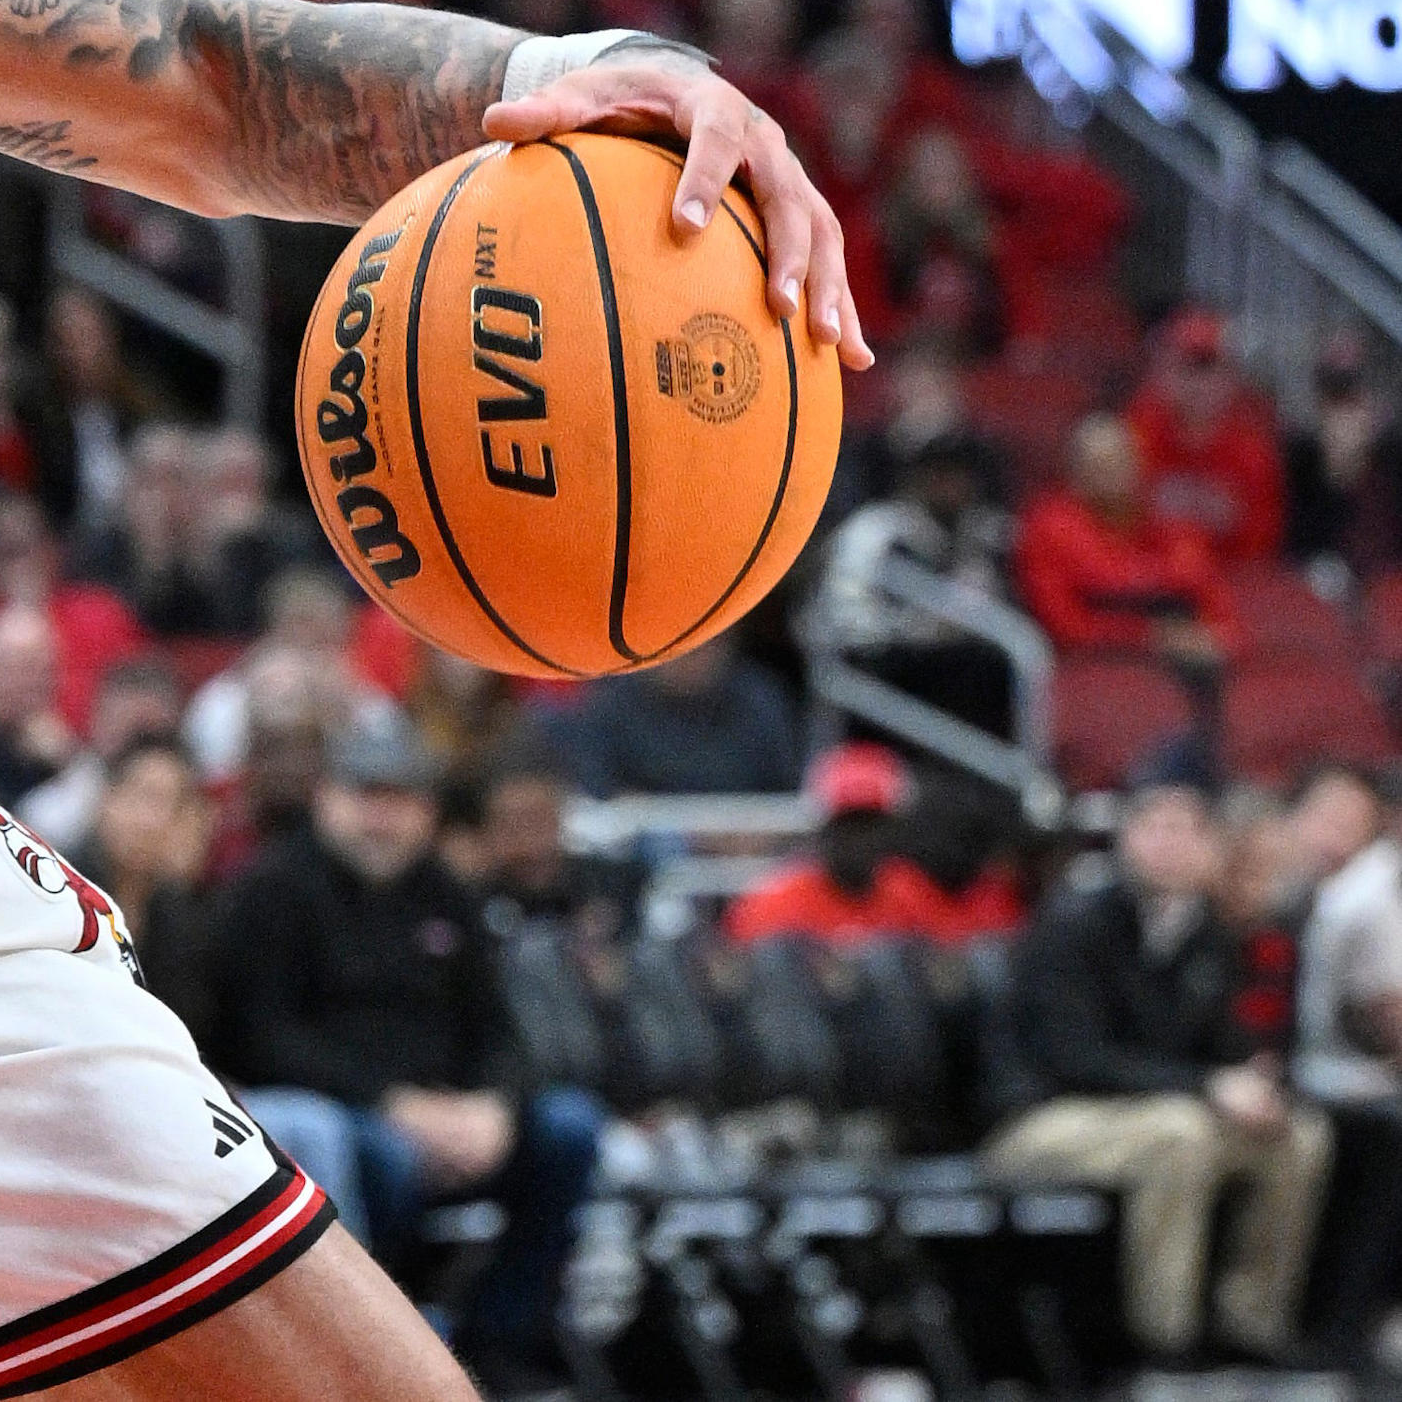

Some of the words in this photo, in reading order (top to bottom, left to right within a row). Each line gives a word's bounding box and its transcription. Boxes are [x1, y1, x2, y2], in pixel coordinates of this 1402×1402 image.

[475, 220, 498, 280] NXT
[317, 220, 421, 590] Wilson
[470, 284, 558, 498] EVO
